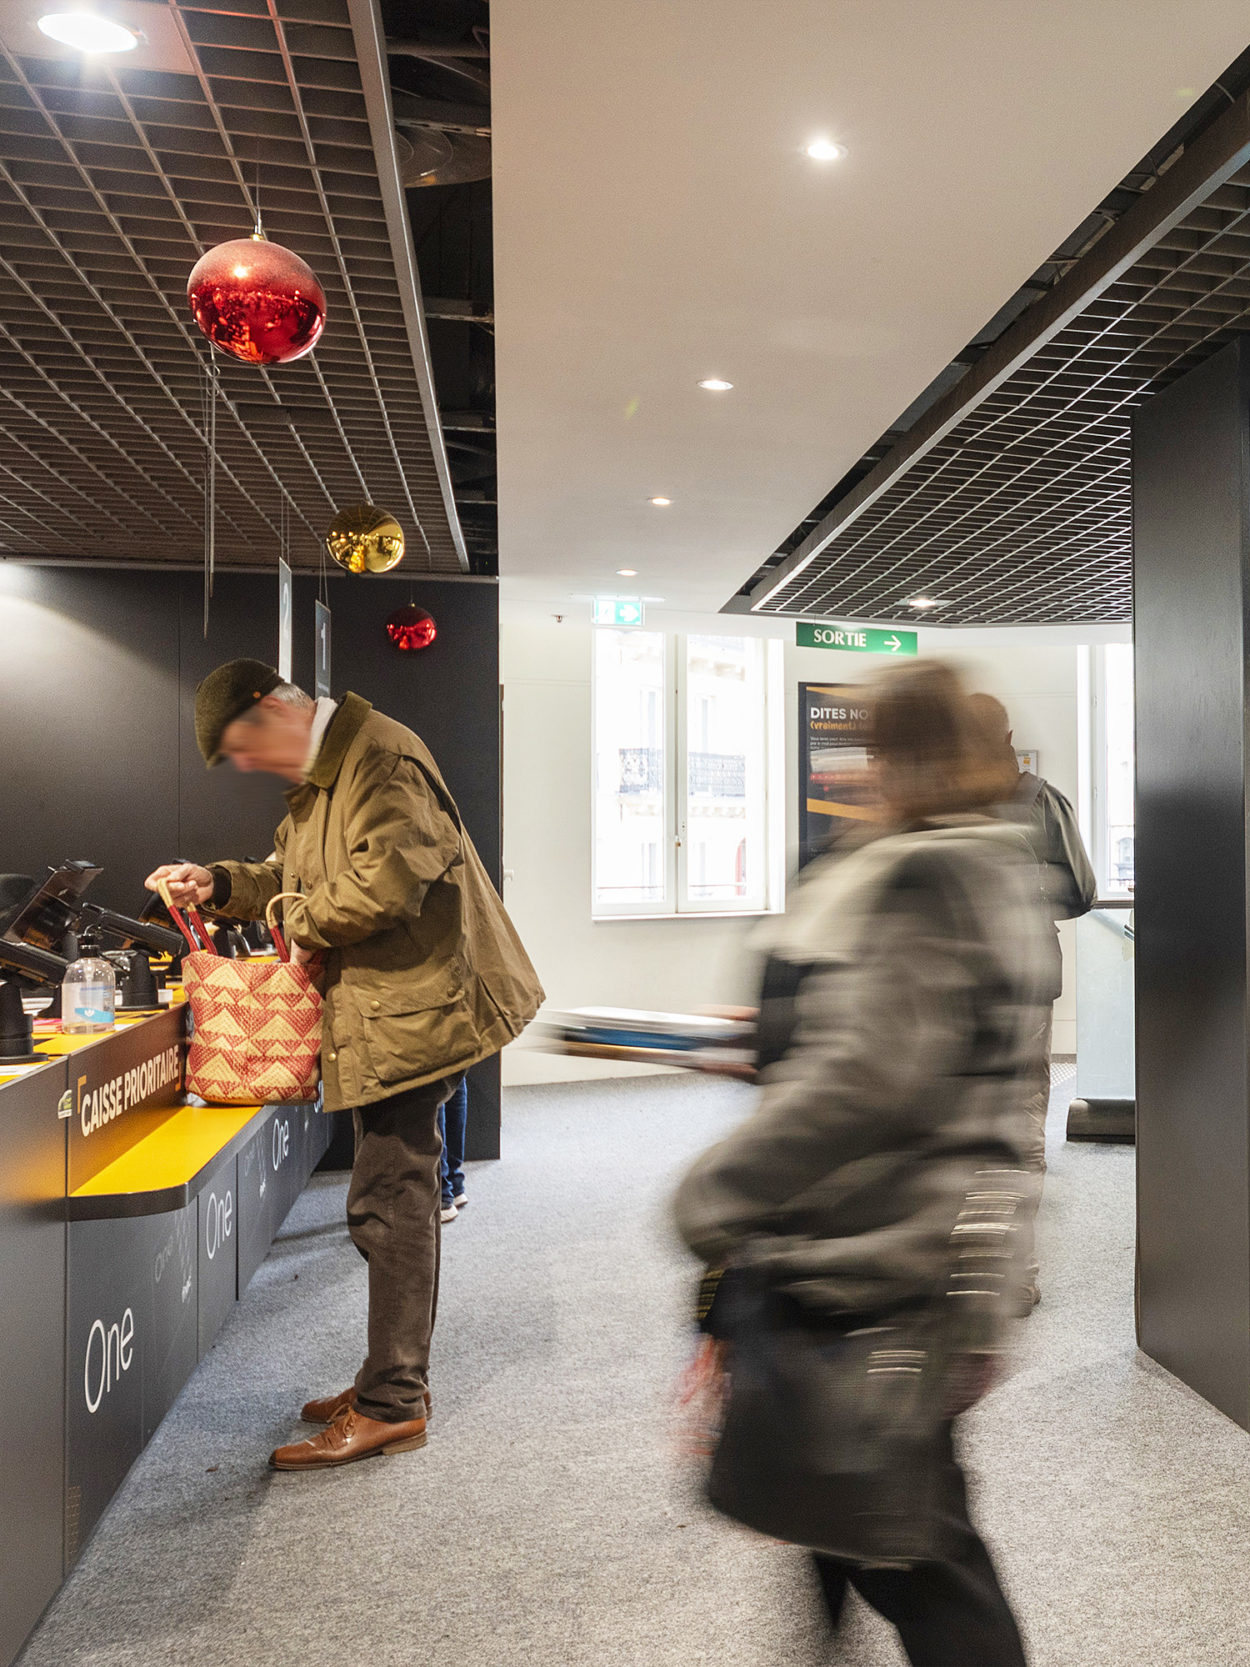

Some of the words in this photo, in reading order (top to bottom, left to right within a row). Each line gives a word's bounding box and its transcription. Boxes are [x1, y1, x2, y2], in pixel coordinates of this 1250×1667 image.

[813, 629, 867, 647] SORTIE
[810, 707, 846, 719] DITES
[850, 710, 869, 720] NO
[81, 1076, 123, 1137] CAISSE
[124, 1044, 179, 1111] PRIORITAIRE
[272, 1118, 289, 1171] One
[206, 1190, 232, 1260] One
[85, 1307, 133, 1413] One
